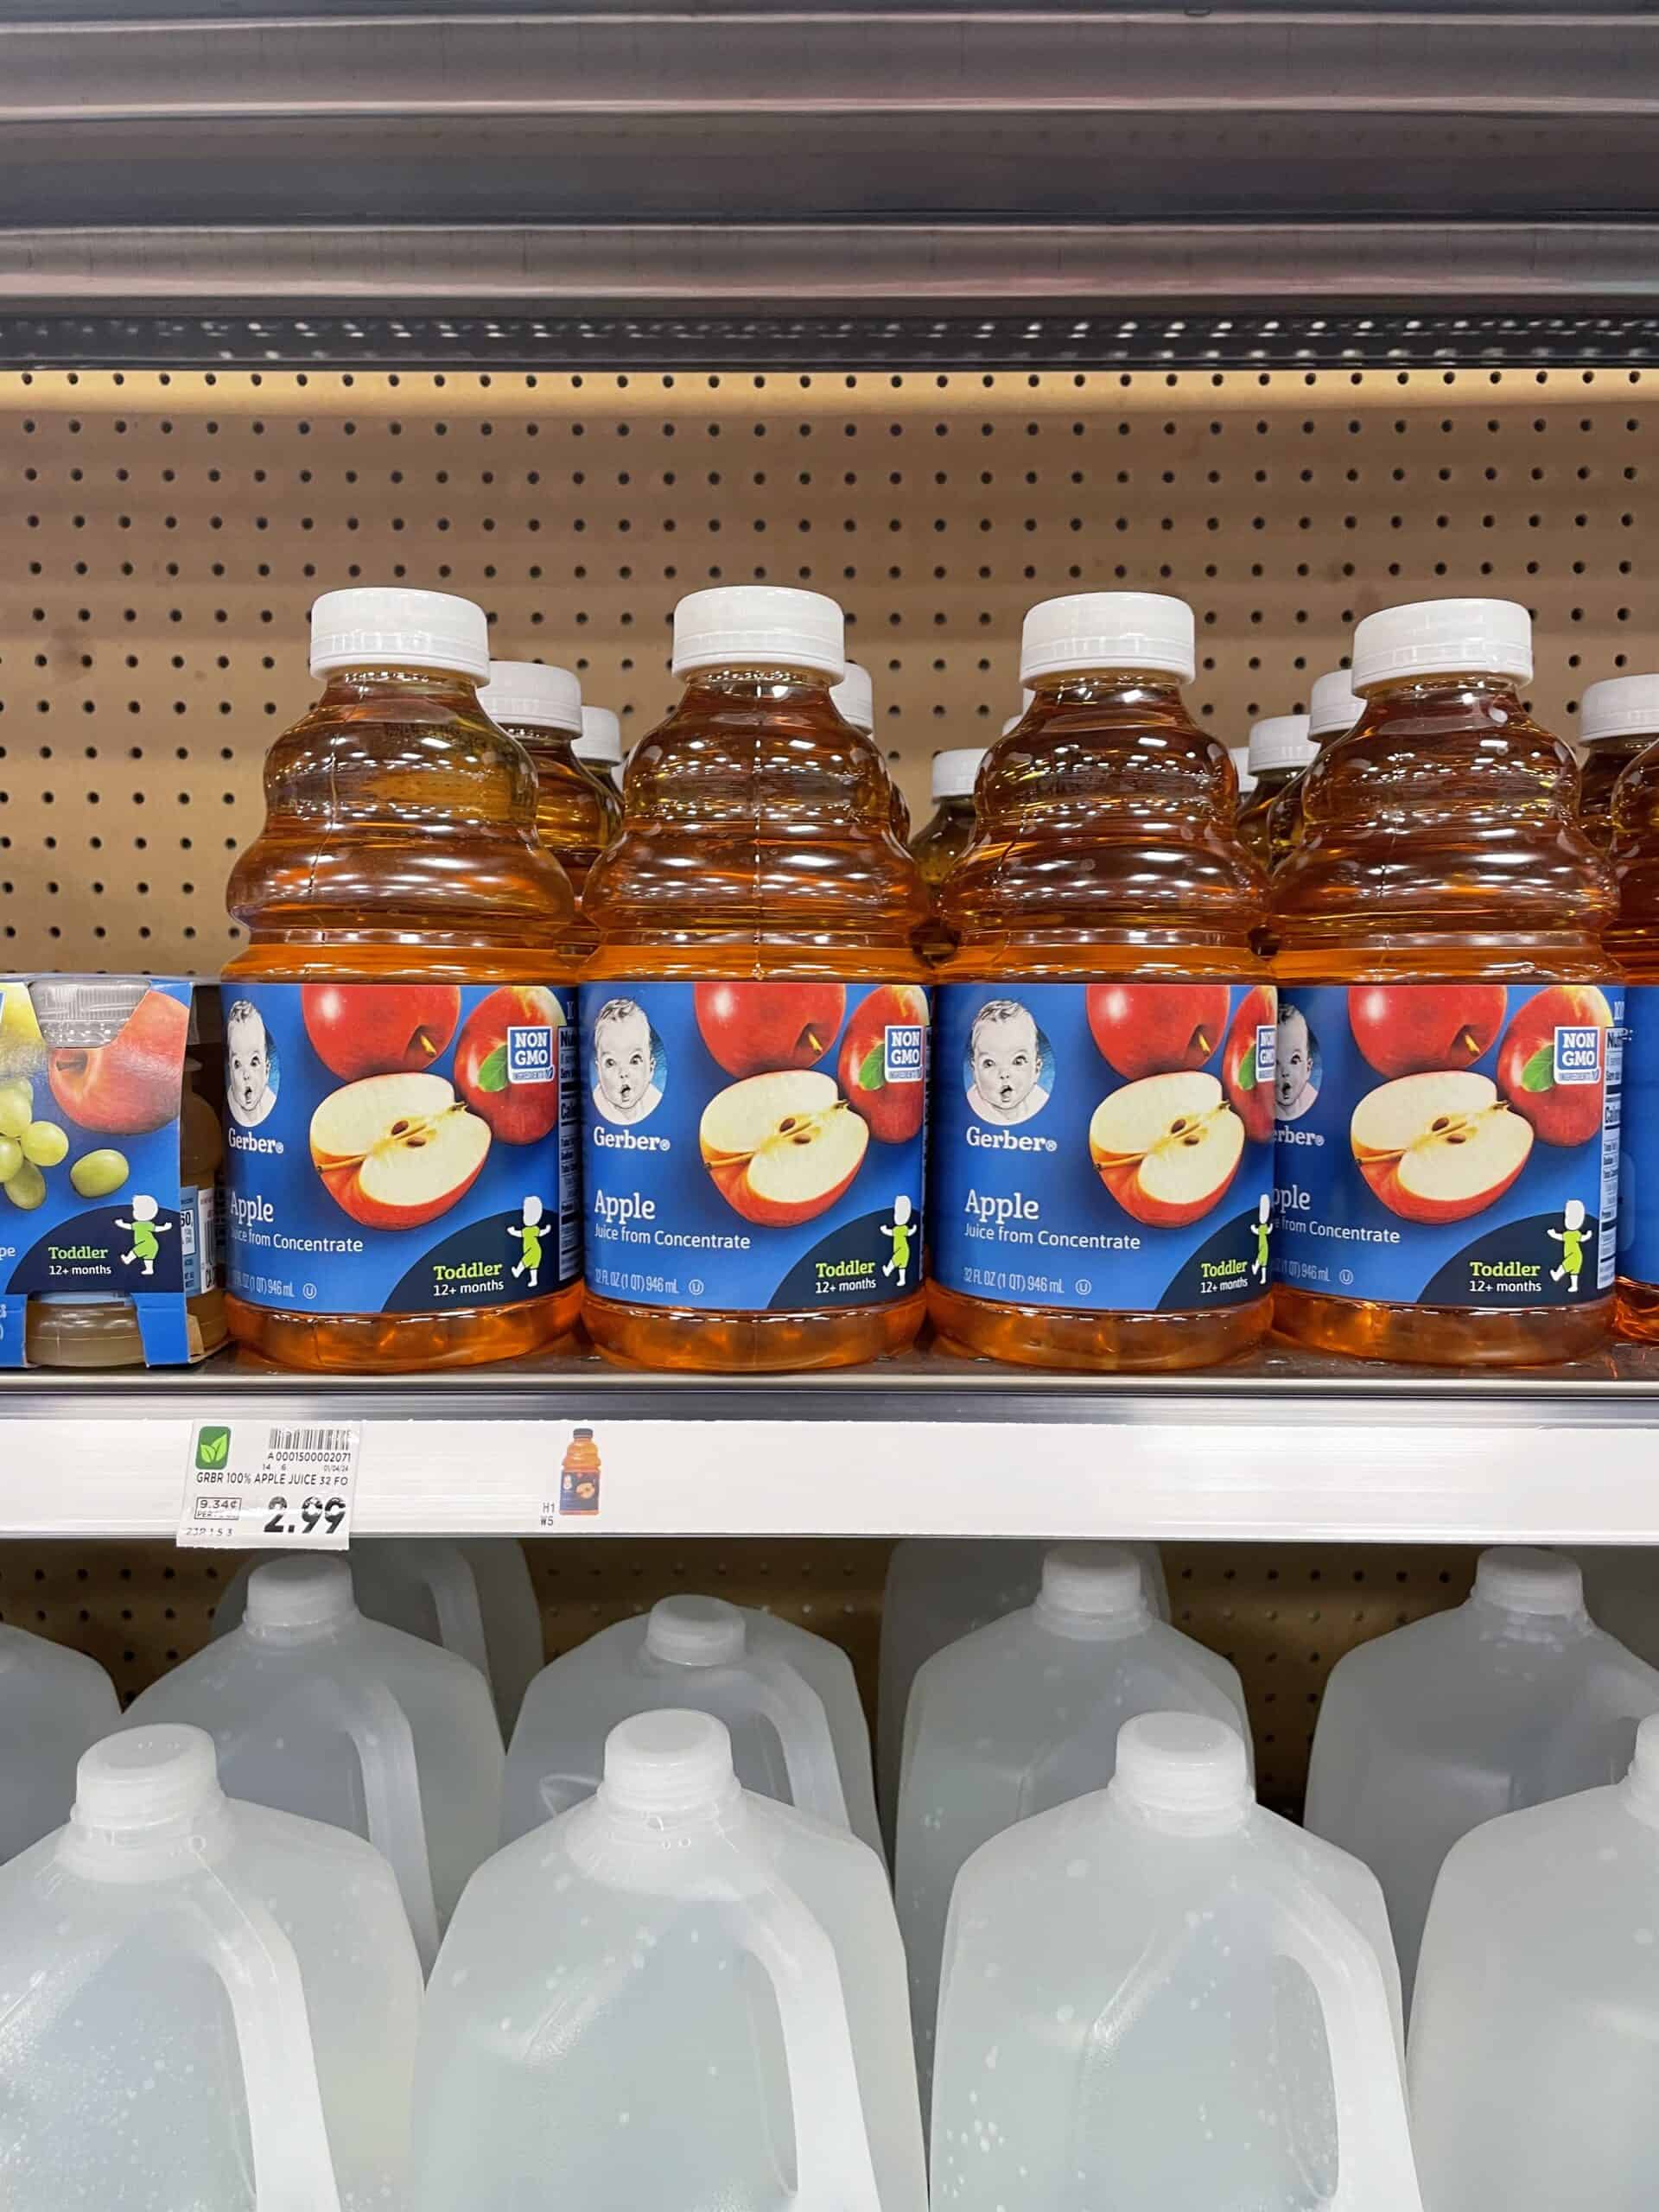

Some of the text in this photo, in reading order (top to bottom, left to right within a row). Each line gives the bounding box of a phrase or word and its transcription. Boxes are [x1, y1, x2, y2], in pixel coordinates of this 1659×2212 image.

[515, 1032, 549, 1048] NON
[891, 1031, 920, 1046] NON
[1562, 1033, 1596, 1048] NON
[514, 1049, 548, 1065] GMO
[891, 1049, 919, 1065] GMO
[1561, 1050, 1595, 1066] GMO
[594, 1189, 656, 1224] Apple
[965, 1189, 1039, 1224] Apple
[1272, 1185, 1311, 1214] pple
[230, 1191, 274, 1227] Apple
[594, 1224, 751, 1249] Juice from Concentrate
[964, 1224, 1141, 1249] Juice from Concentrate
[1282, 1217, 1306, 1233] from
[1309, 1221, 1401, 1243] Concentrate
[249, 1229, 270, 1247] from
[273, 1234, 363, 1252] Concentrate
[48, 1246, 108, 1260] Toddler
[48, 1265, 111, 1275] 12+ months
[433, 1262, 503, 1281] Toddler
[816, 1260, 875, 1278] Toddler
[1201, 1259, 1248, 1278] Toddler
[1470, 1262, 1541, 1276] Toddler
[434, 1279, 505, 1296] 12+ months
[645, 1276, 664, 1293] 946
[664, 1279, 679, 1294] mL
[816, 1279, 876, 1294] 12+ months
[973, 1268, 982, 1285] FL
[983, 1270, 995, 1286] OZ
[1008, 1274, 1026, 1292] QT)
[1027, 1275, 1047, 1293] 946
[1049, 1278, 1065, 1294] mL
[1200, 1277, 1249, 1294] 12+ months
[1469, 1280, 1541, 1292] 12+ months
[276, 1452, 351, 1462] 0001500002071
[196, 1471, 223, 1484] GRBR
[226, 1472, 251, 1484] 100%
[254, 1473, 286, 1484] APPLE
[288, 1474, 316, 1485] JUICE
[320, 1476, 331, 1485] 32
[264, 1496, 346, 1534] 2.99
